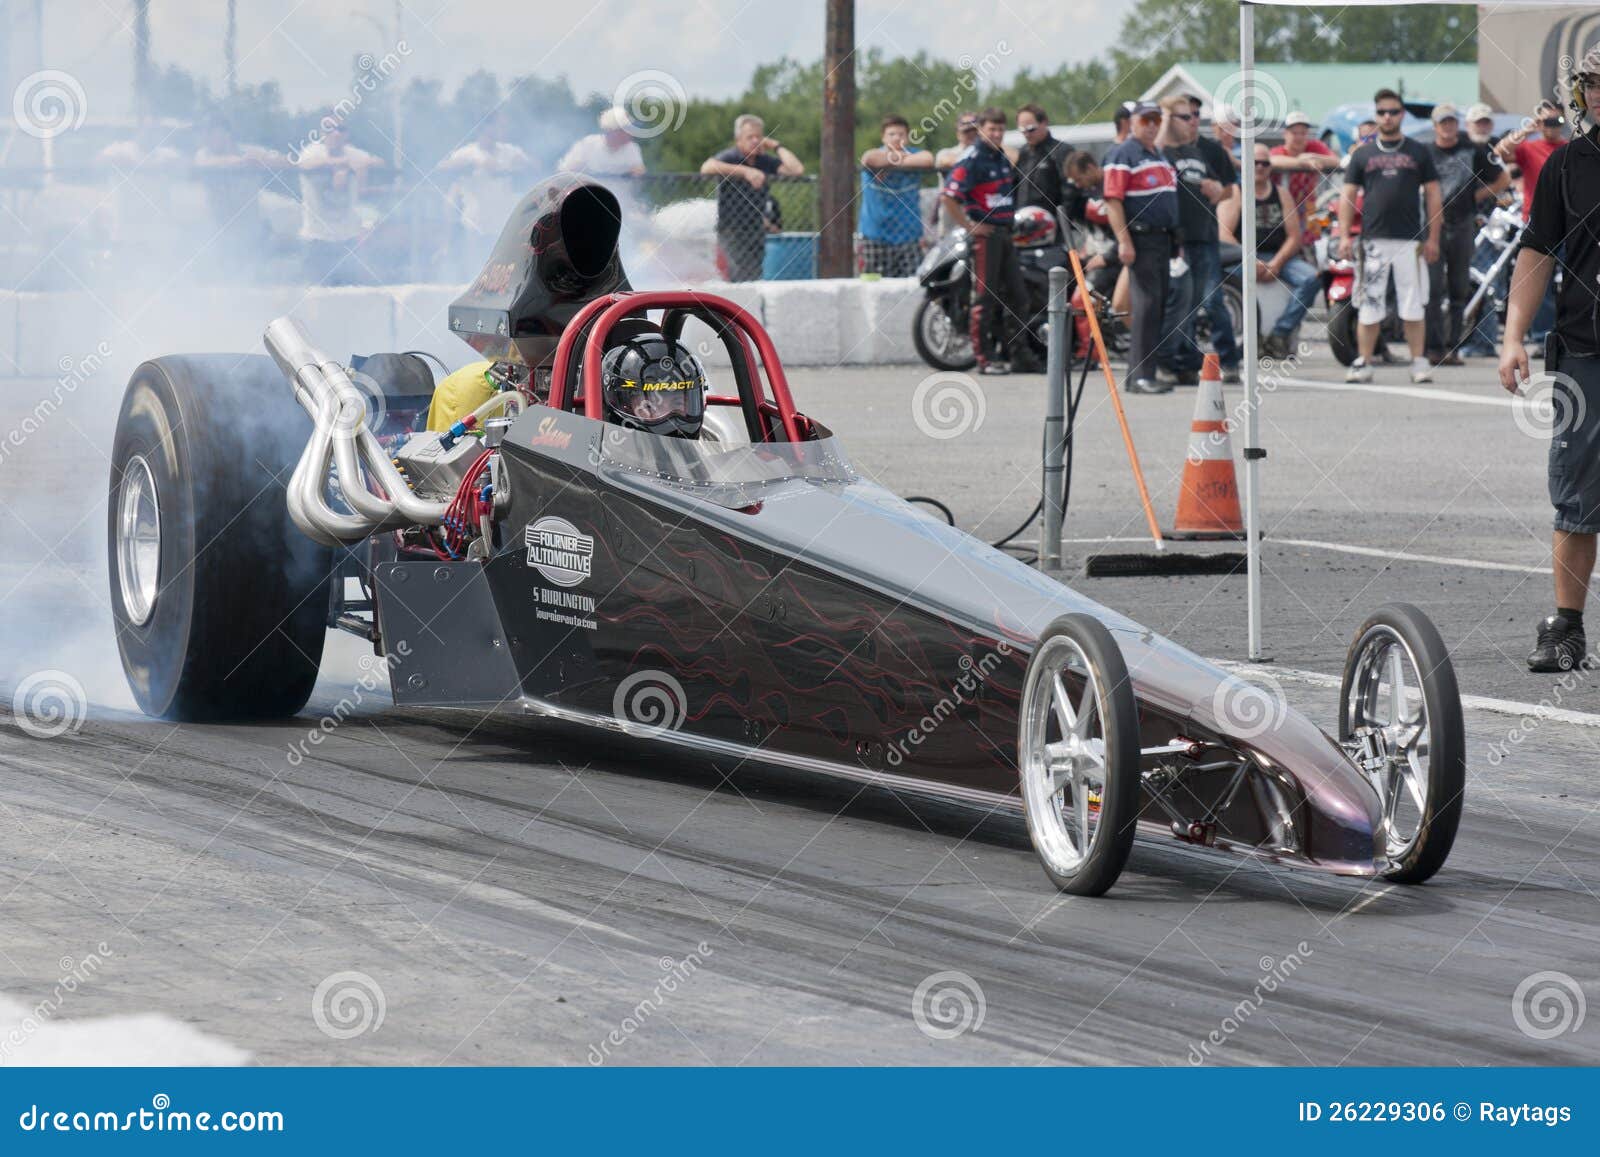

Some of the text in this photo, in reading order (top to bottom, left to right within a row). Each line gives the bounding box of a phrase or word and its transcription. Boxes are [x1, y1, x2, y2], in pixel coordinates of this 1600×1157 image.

[540, 531, 578, 552] FOURNIER
[529, 545, 590, 572] AUTOMOTIVE
[541, 588, 595, 613] BURLINGTON
